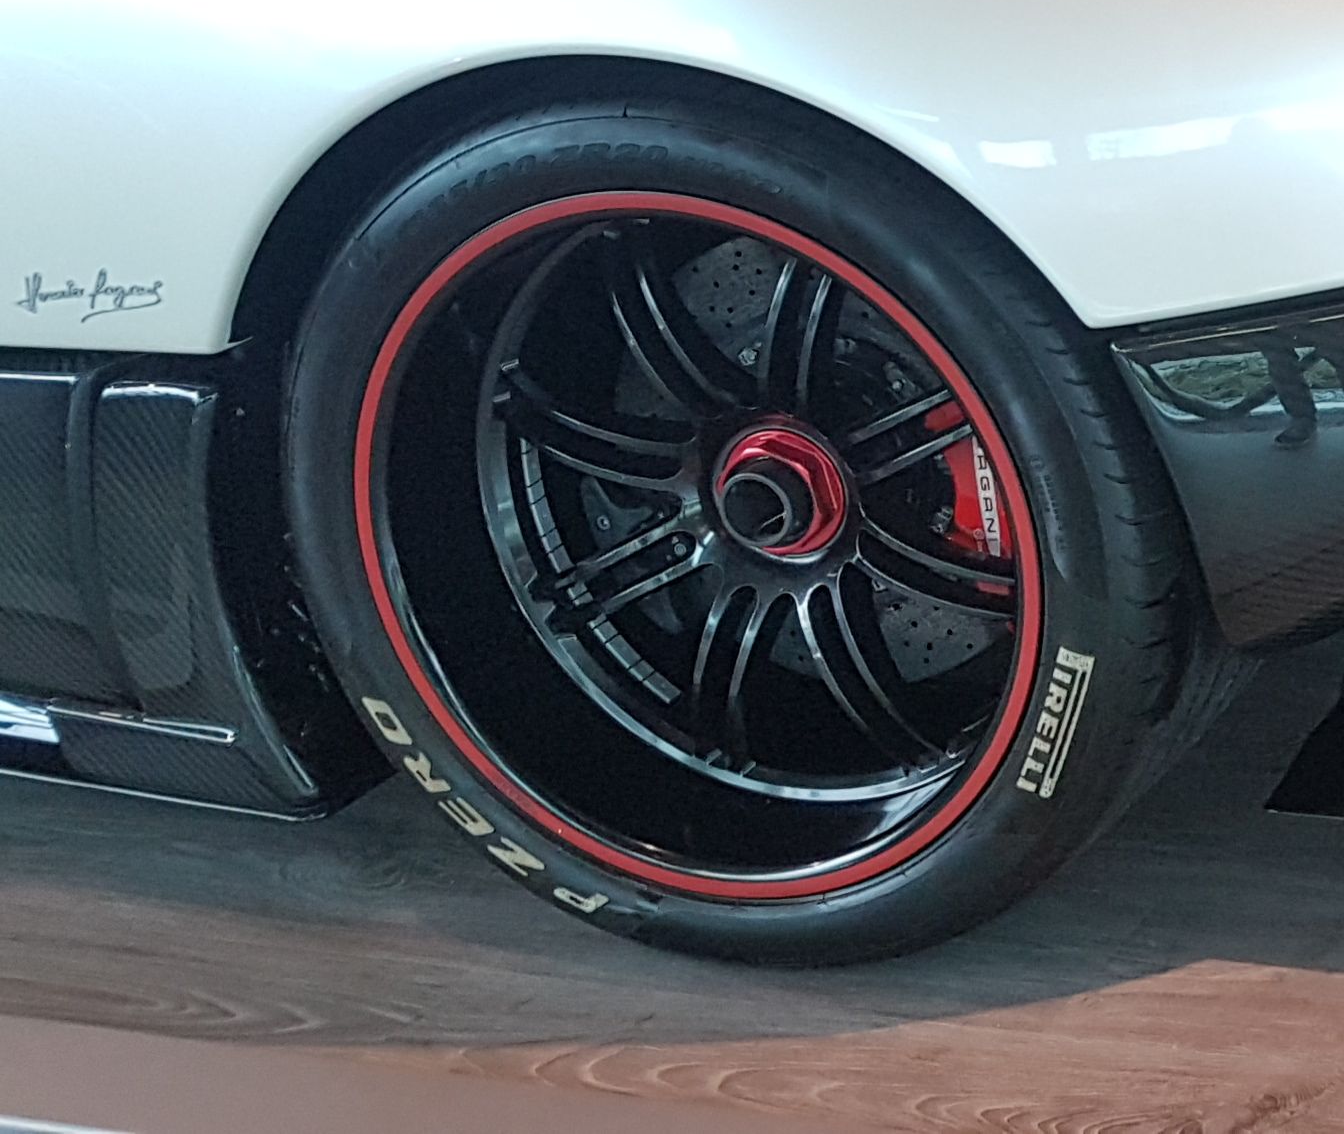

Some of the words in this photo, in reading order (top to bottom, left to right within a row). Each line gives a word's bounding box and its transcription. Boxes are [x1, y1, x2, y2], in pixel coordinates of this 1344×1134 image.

[976, 454, 998, 543] AGANI
[1016, 645, 1096, 799] PIRELLI
[361, 696, 546, 877] ZERO
[553, 887, 609, 913] P
